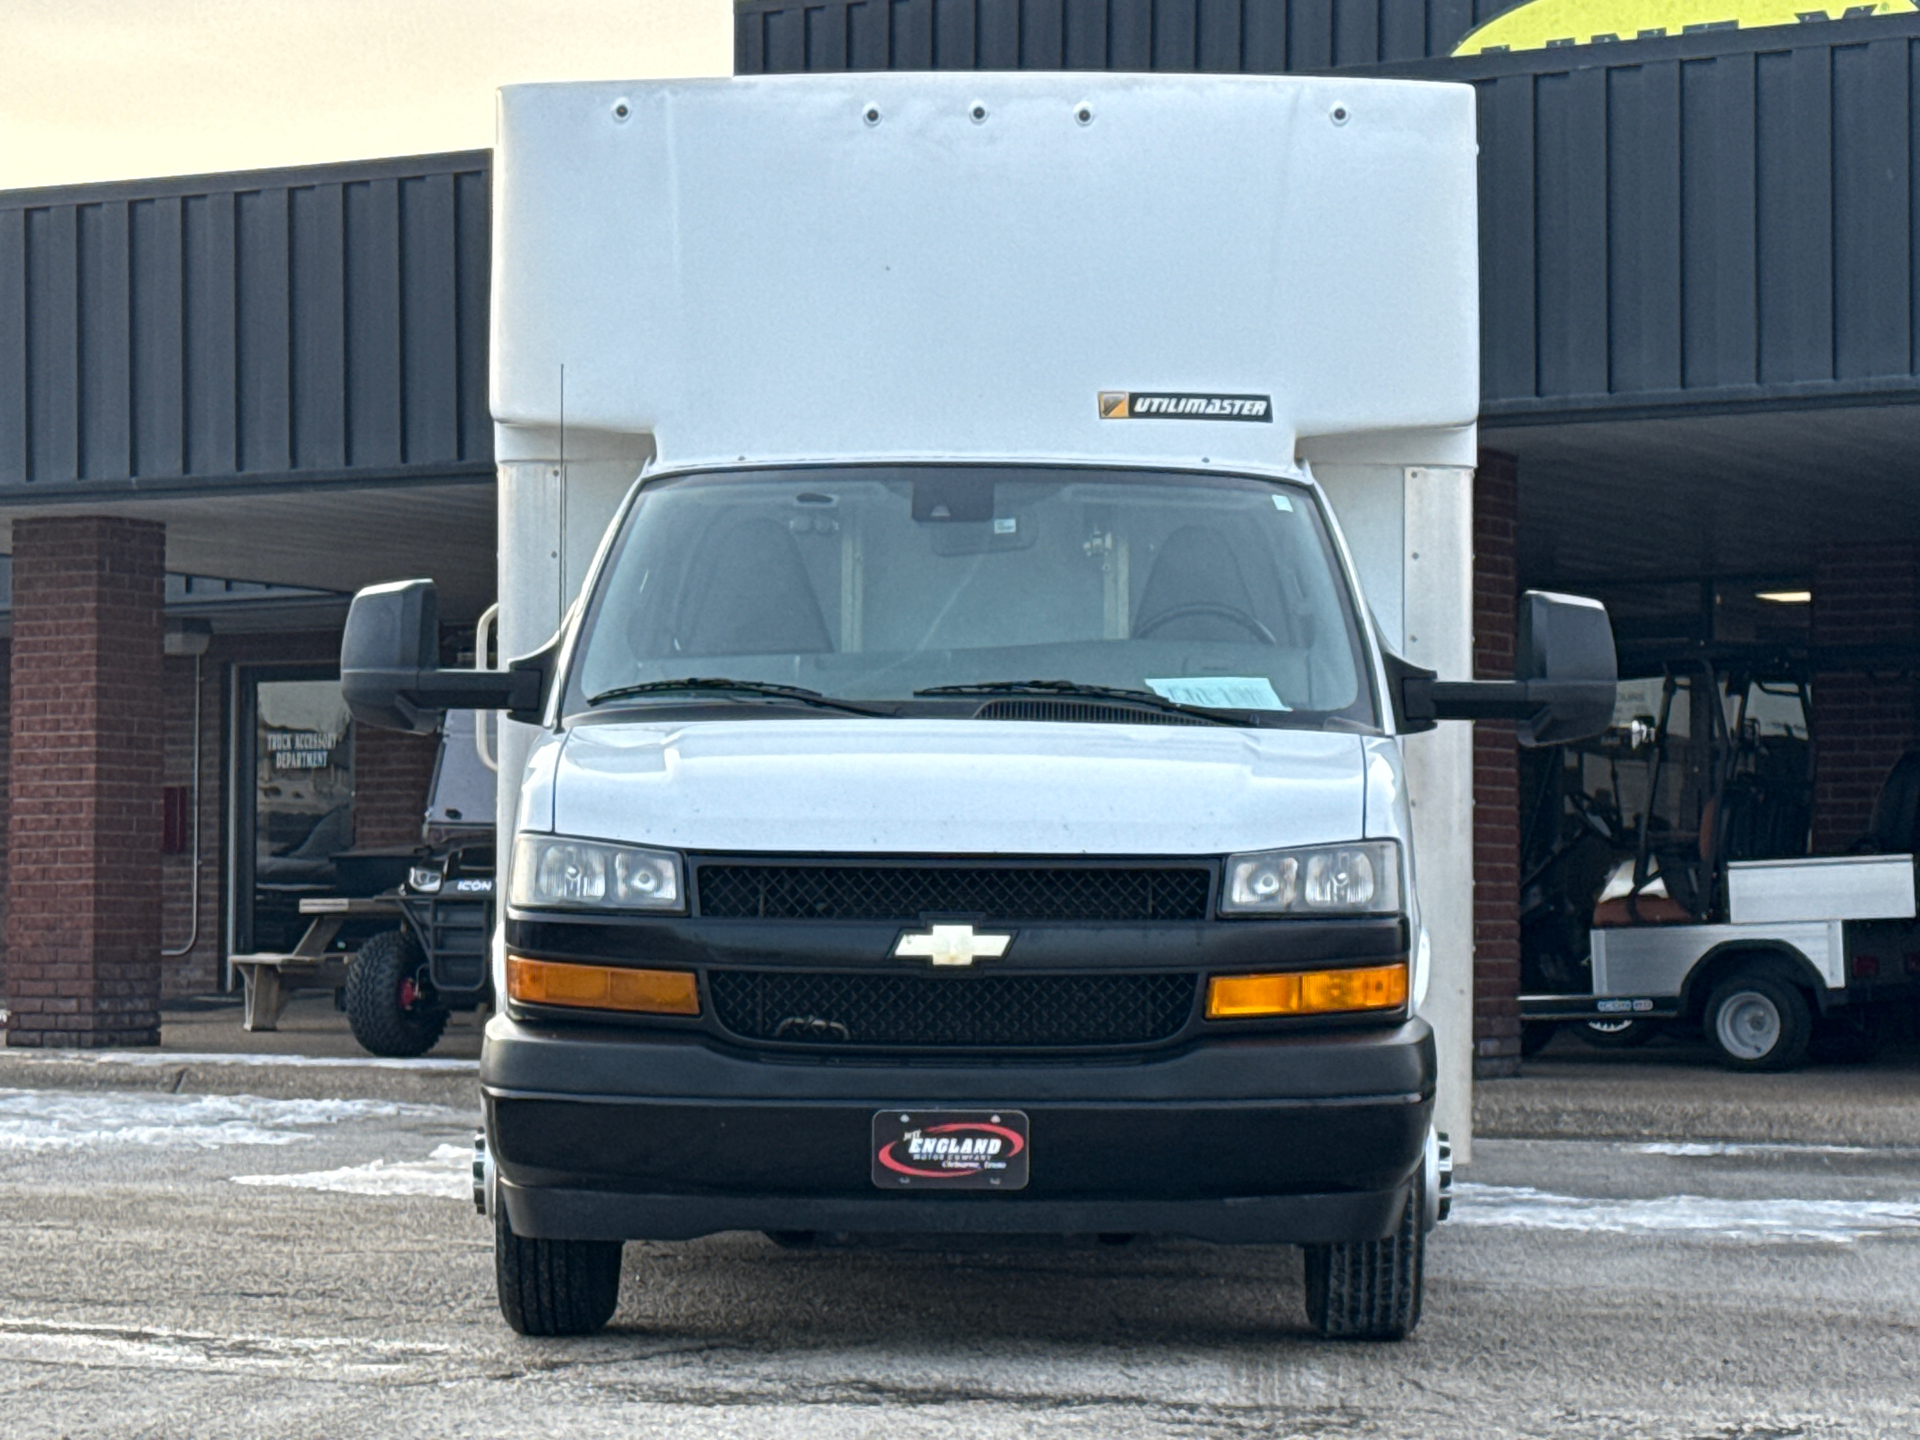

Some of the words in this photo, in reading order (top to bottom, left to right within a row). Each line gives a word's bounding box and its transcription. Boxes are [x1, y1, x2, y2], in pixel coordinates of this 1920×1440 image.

[1134, 397, 1267, 416] UTILIMASTER
[267, 733, 292, 751] TRUCK
[295, 732, 337, 750] ACCESSORY
[276, 751, 328, 769] DEPARTMENT
[457, 880, 492, 891] ICON
[908, 1137, 1002, 1154] ENGLAND
